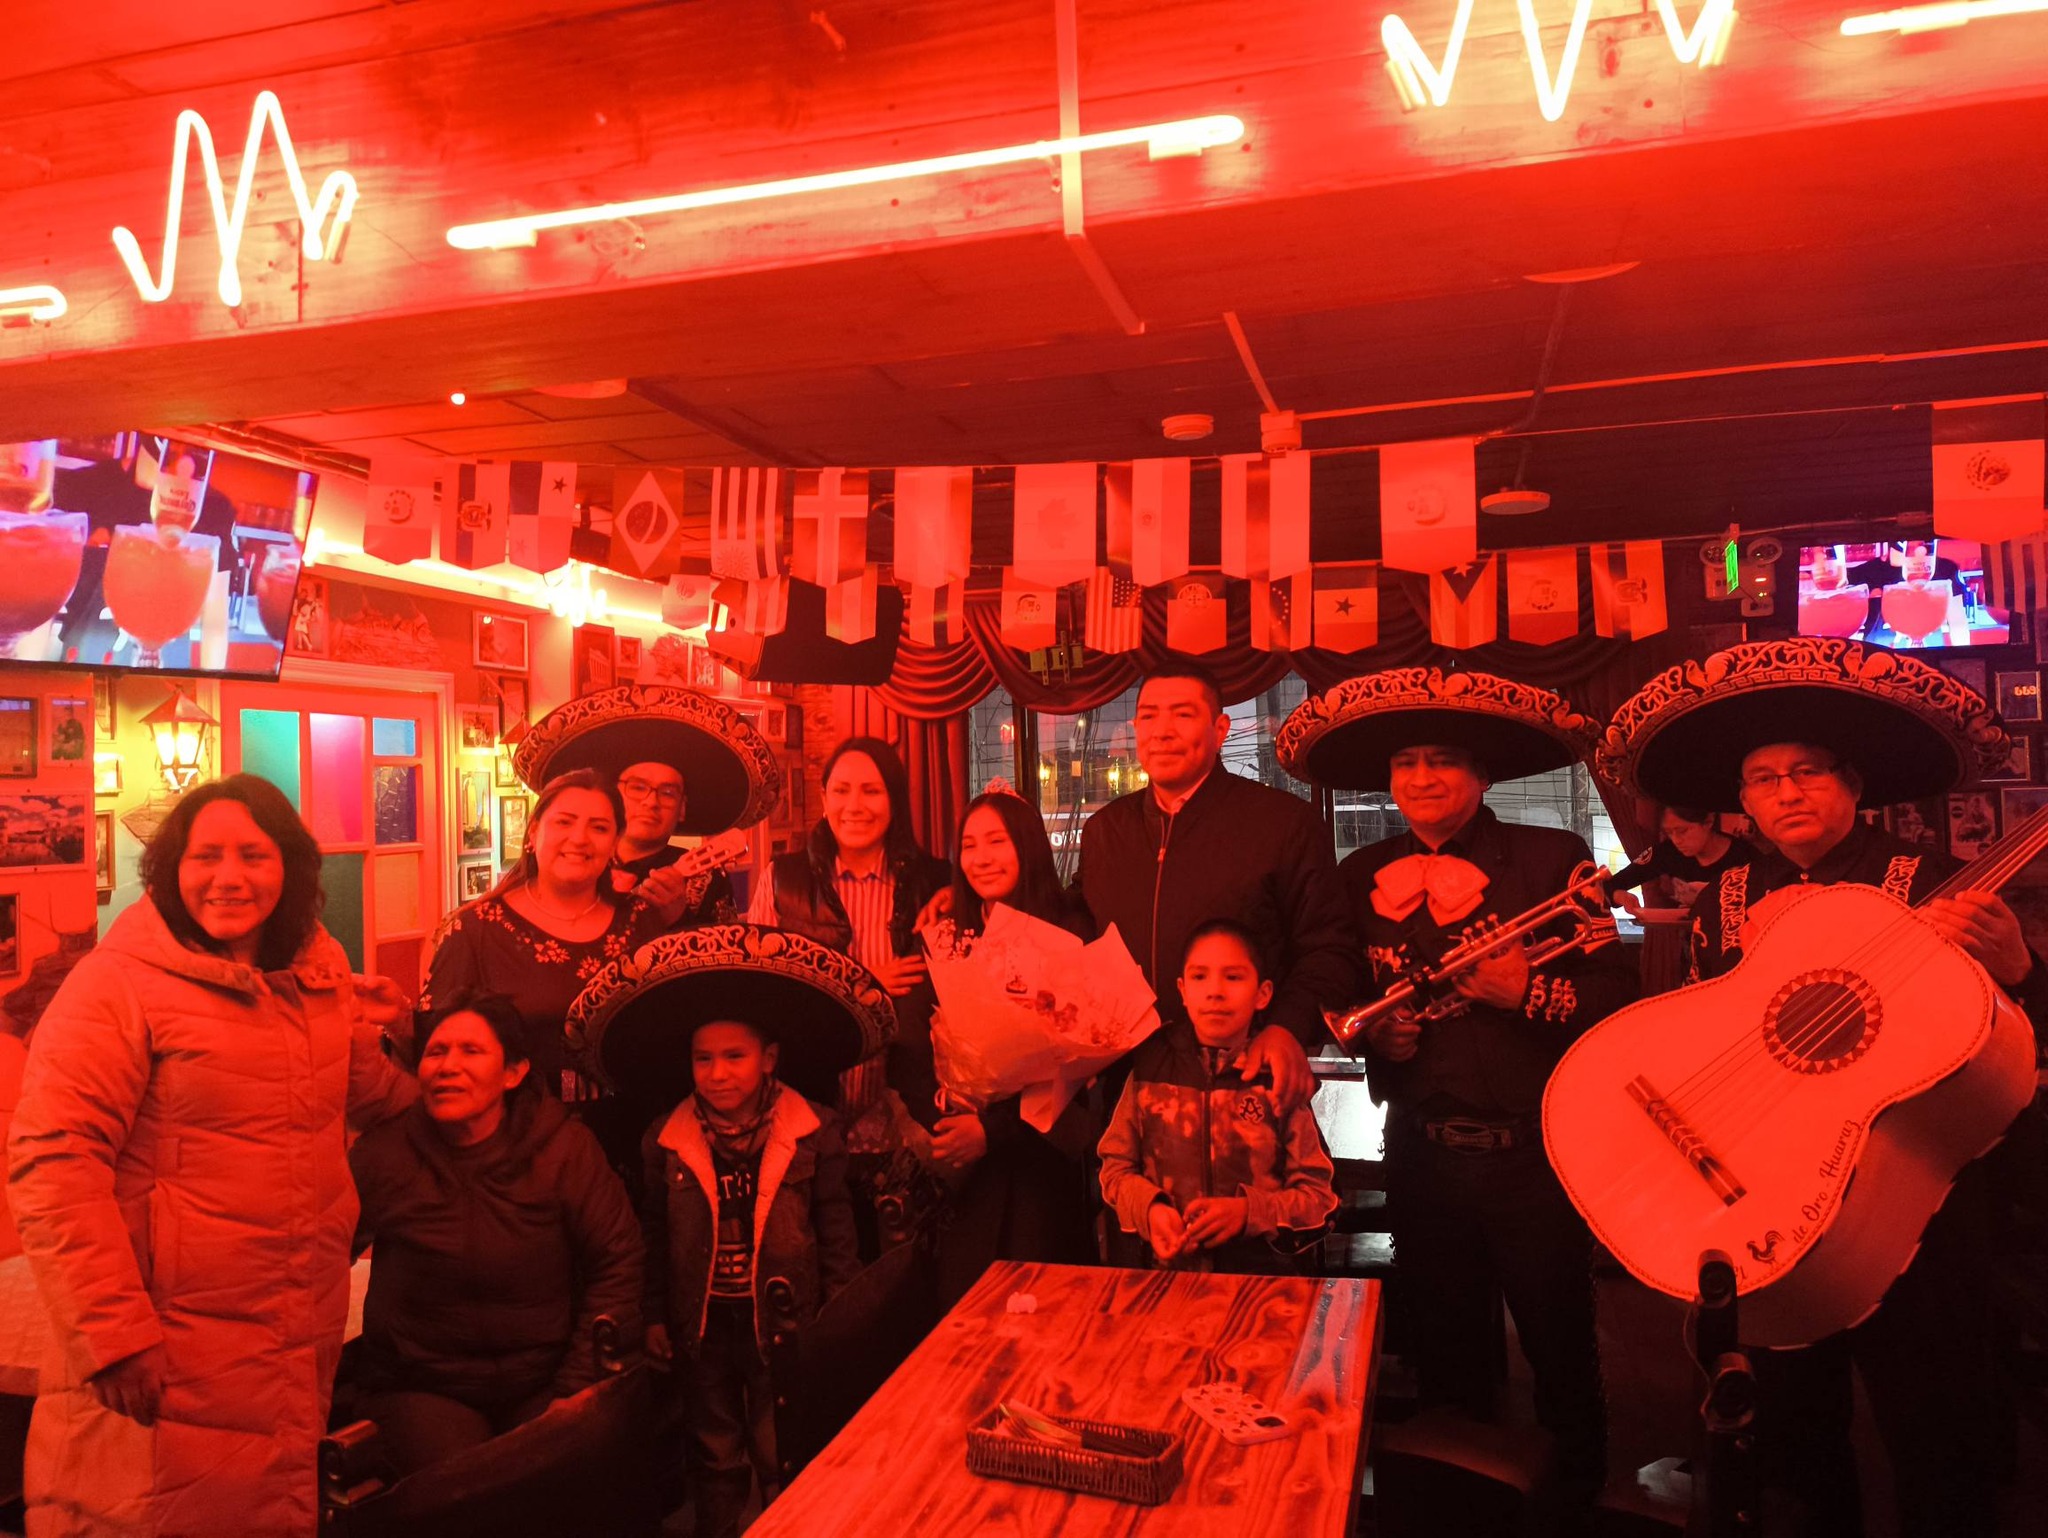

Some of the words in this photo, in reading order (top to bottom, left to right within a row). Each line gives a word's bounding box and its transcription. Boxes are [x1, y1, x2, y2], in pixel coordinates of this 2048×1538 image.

[1792, 1226, 1808, 1243] de
[1801, 1191, 1828, 1221] Oro
[1819, 1120, 1861, 1179] Huaraz
